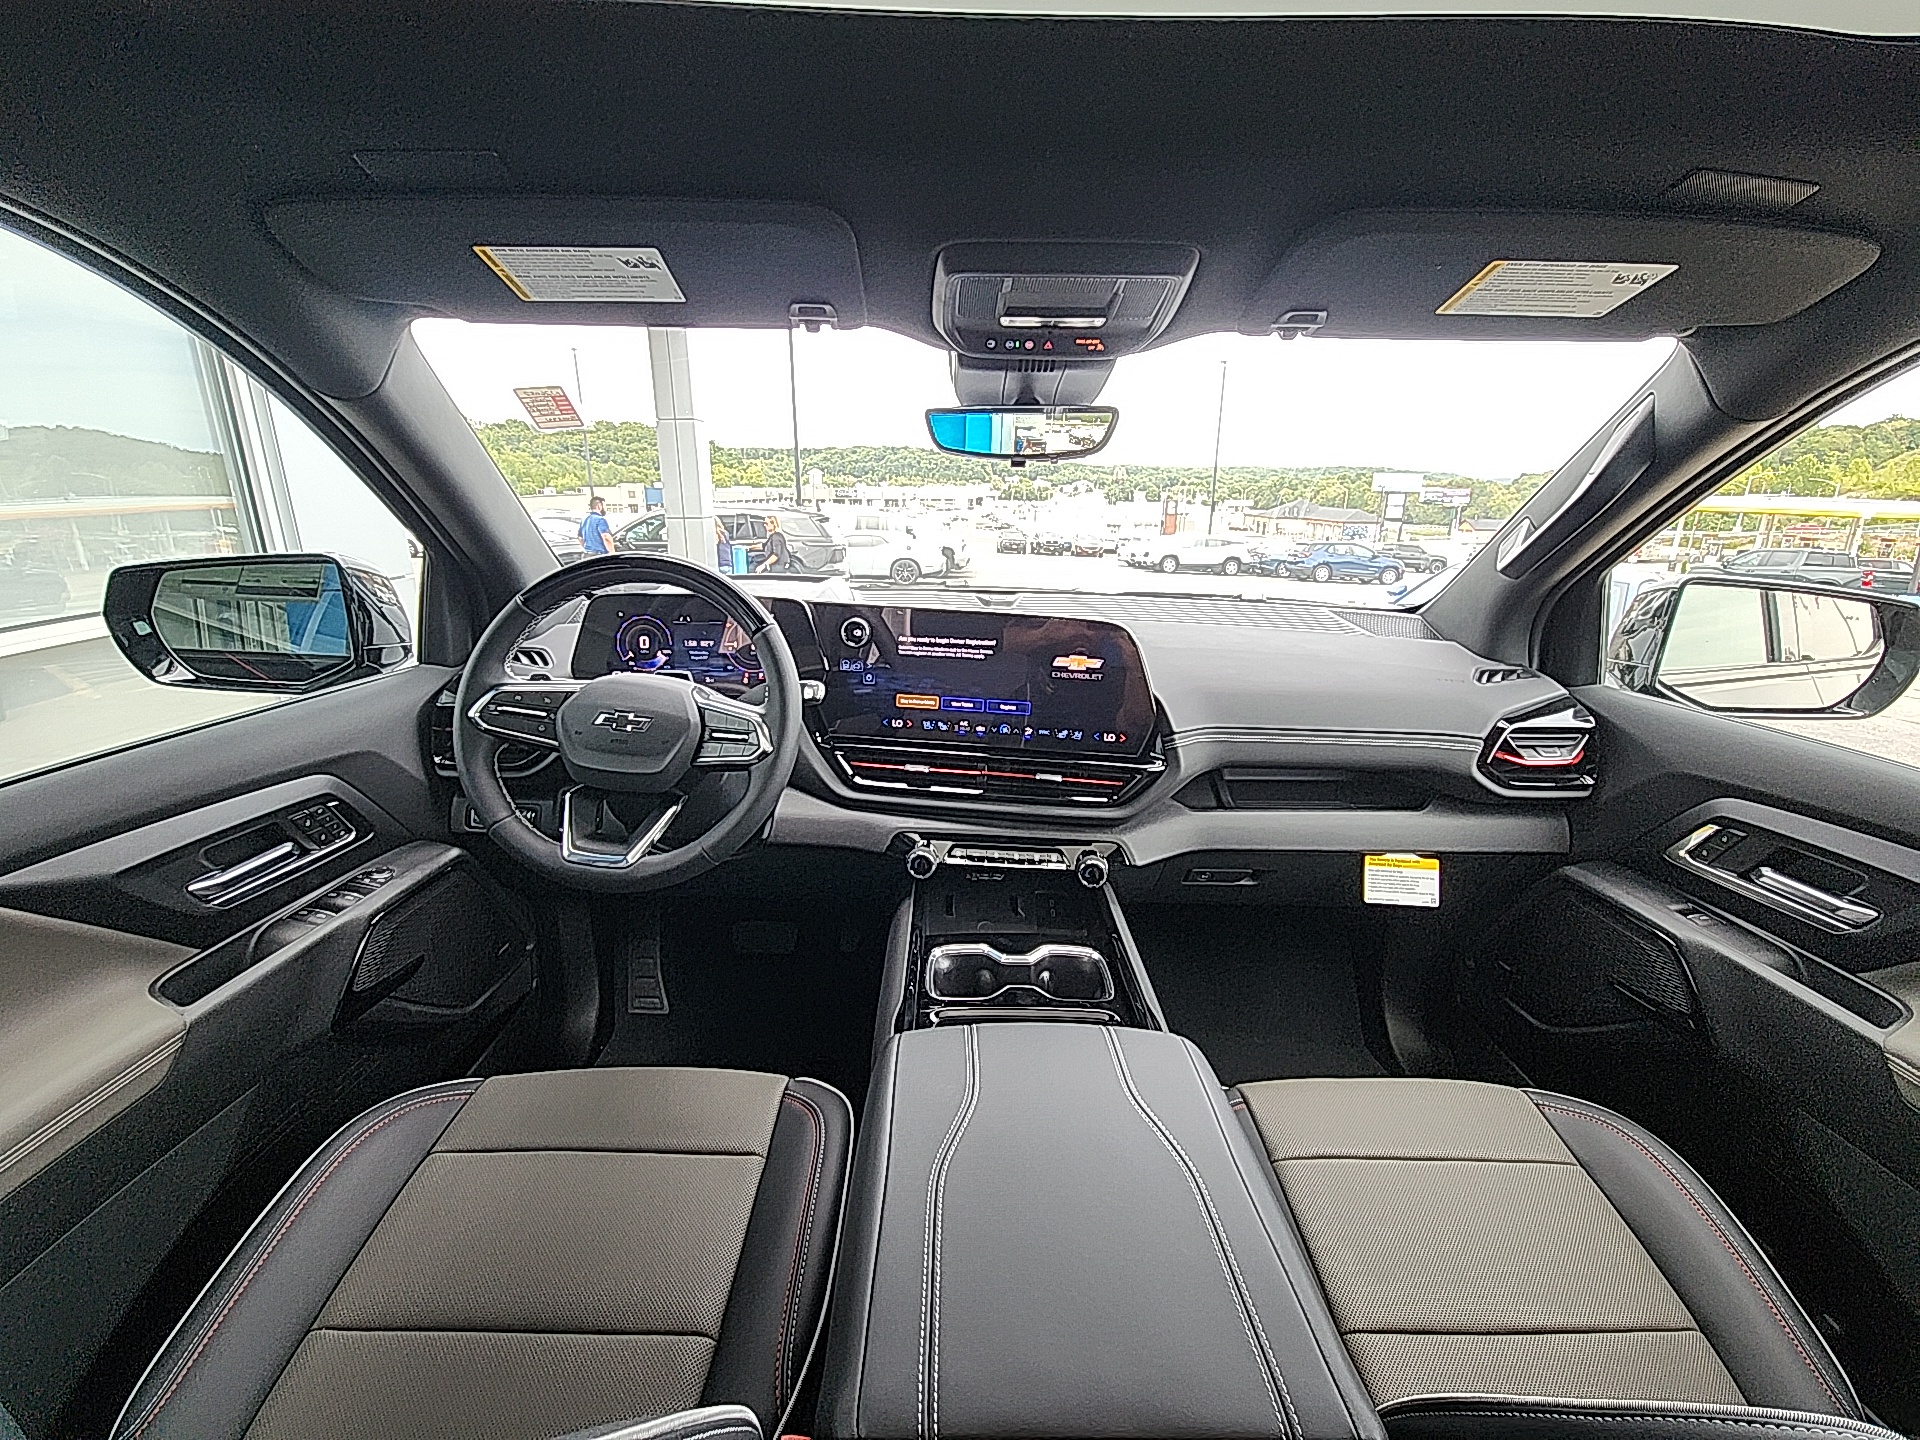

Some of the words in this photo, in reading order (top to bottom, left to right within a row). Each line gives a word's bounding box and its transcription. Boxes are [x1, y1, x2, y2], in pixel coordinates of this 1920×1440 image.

[1051, 671, 1104, 681] CHEVROLET
[892, 718, 904, 728] LO
[1103, 732, 1117, 742] LO
